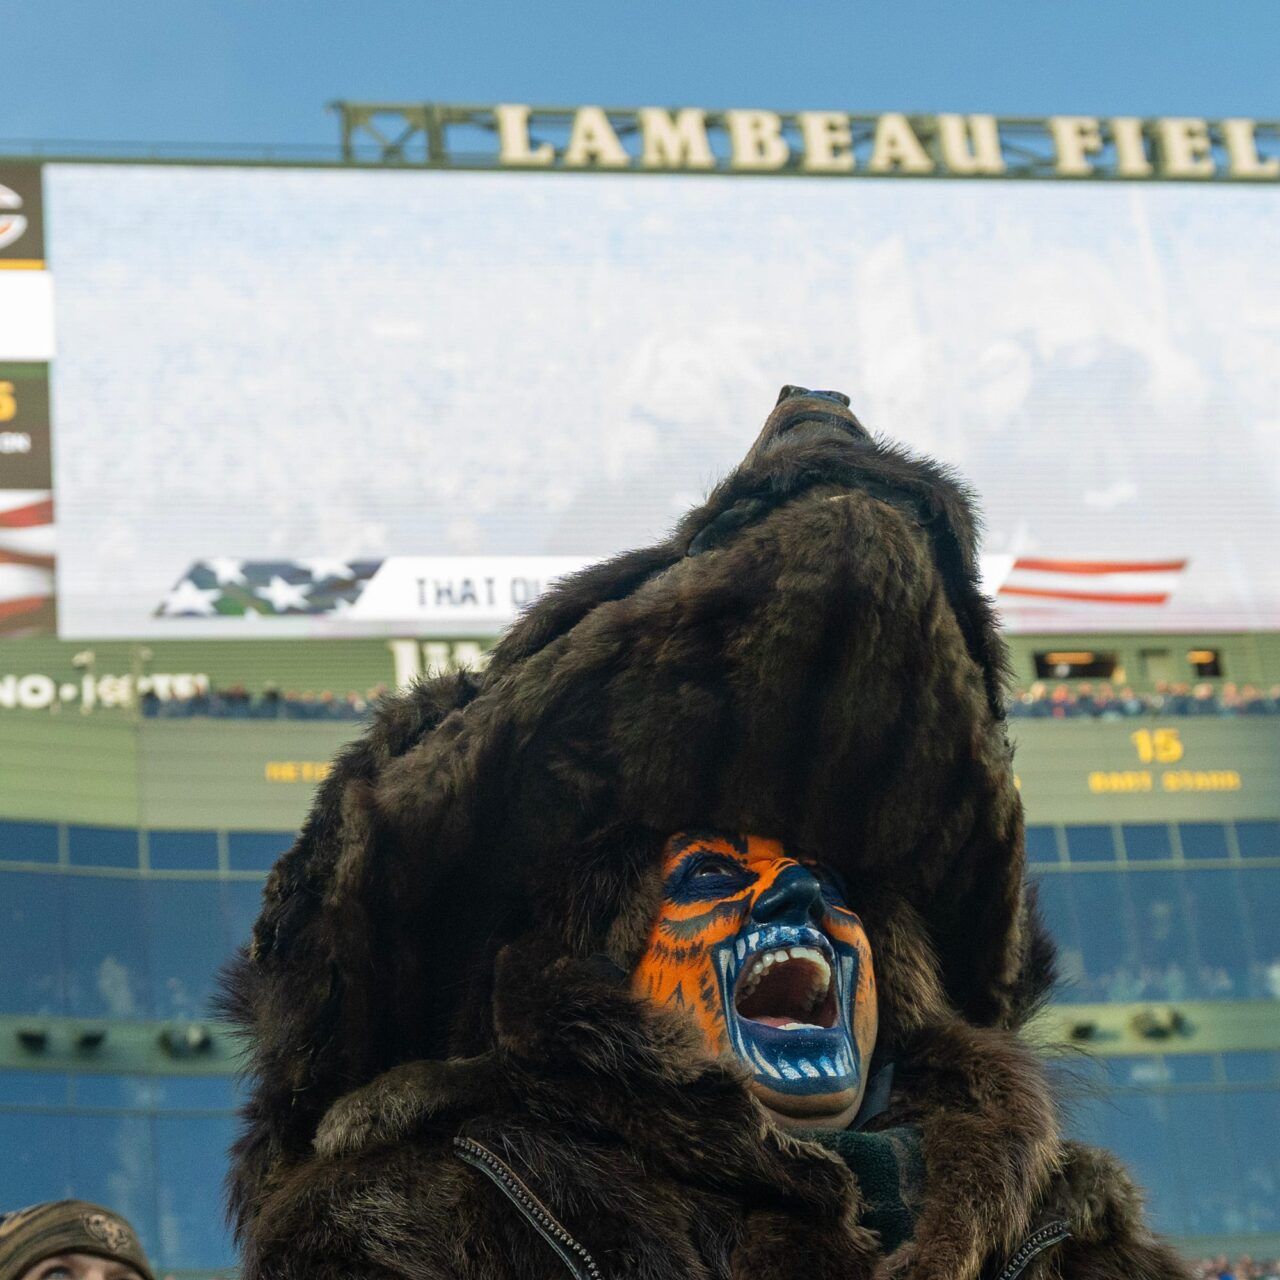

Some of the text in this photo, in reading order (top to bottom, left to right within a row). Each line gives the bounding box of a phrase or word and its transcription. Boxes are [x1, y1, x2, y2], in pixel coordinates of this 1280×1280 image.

[494, 104, 1005, 175] LAMBEAU
[417, 576, 496, 606] THAT
[1130, 727, 1184, 763] 15
